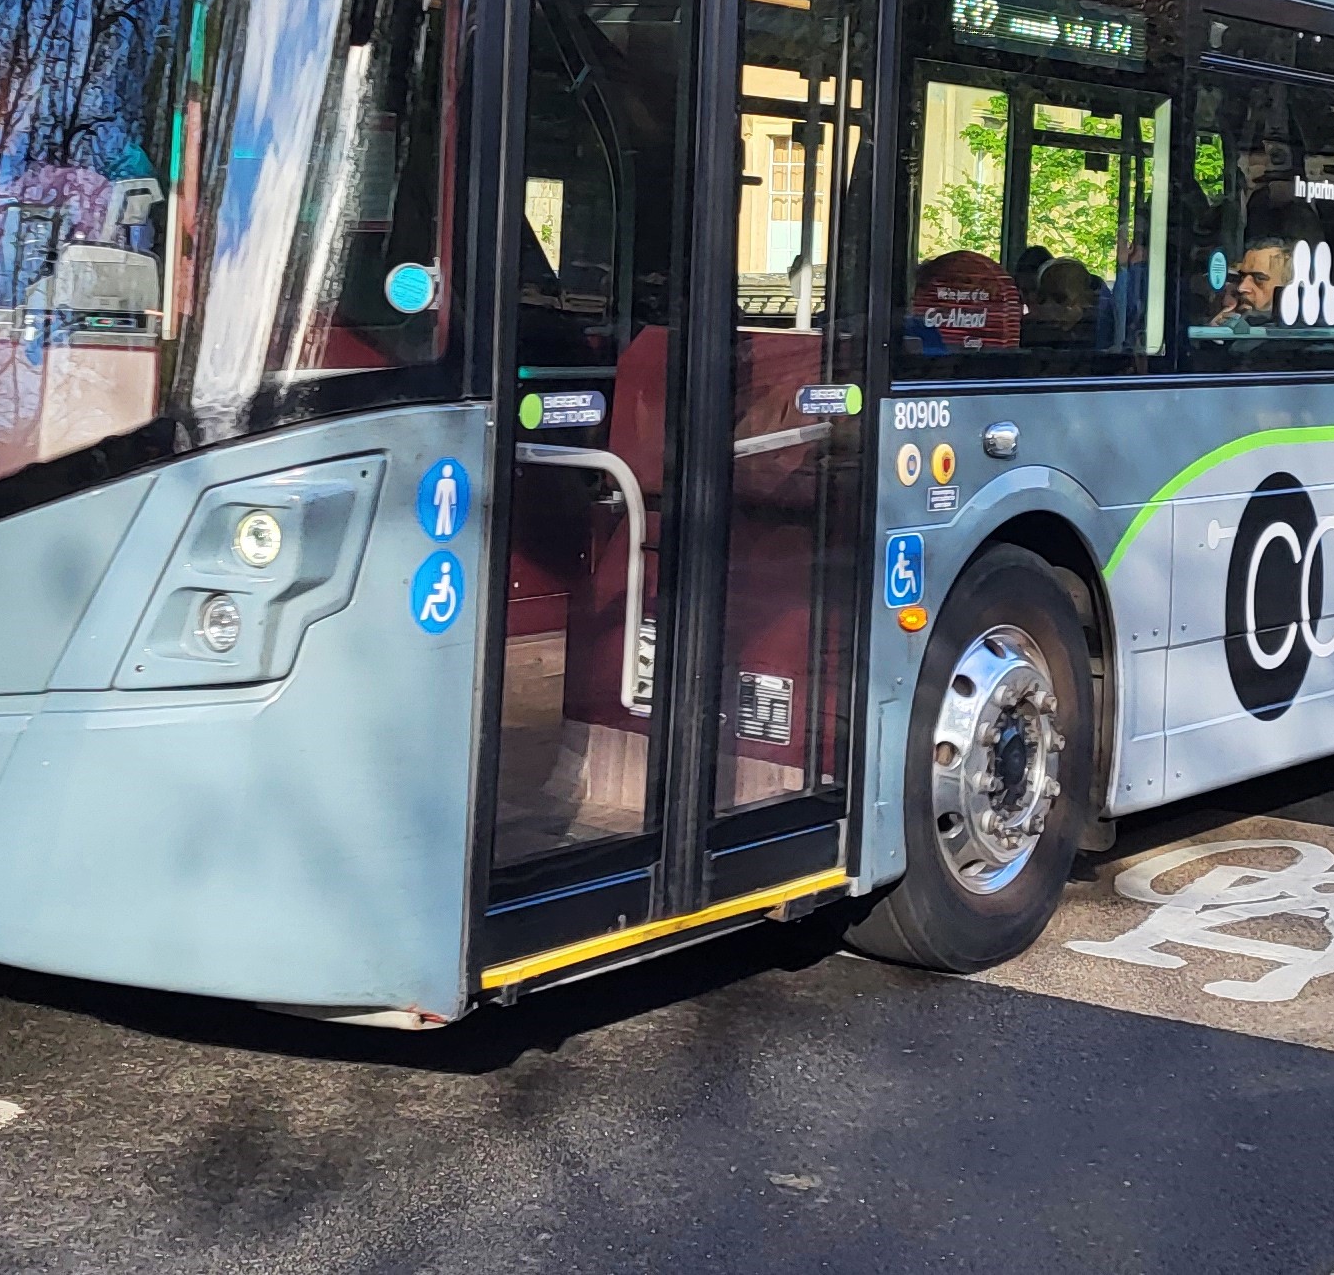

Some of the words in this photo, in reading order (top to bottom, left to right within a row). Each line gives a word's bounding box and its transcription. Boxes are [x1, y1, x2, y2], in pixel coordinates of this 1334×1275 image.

[1294, 175, 1306, 198] In
[924, 307, 988, 328] Go-Ahead
[894, 400, 951, 430] 80906
